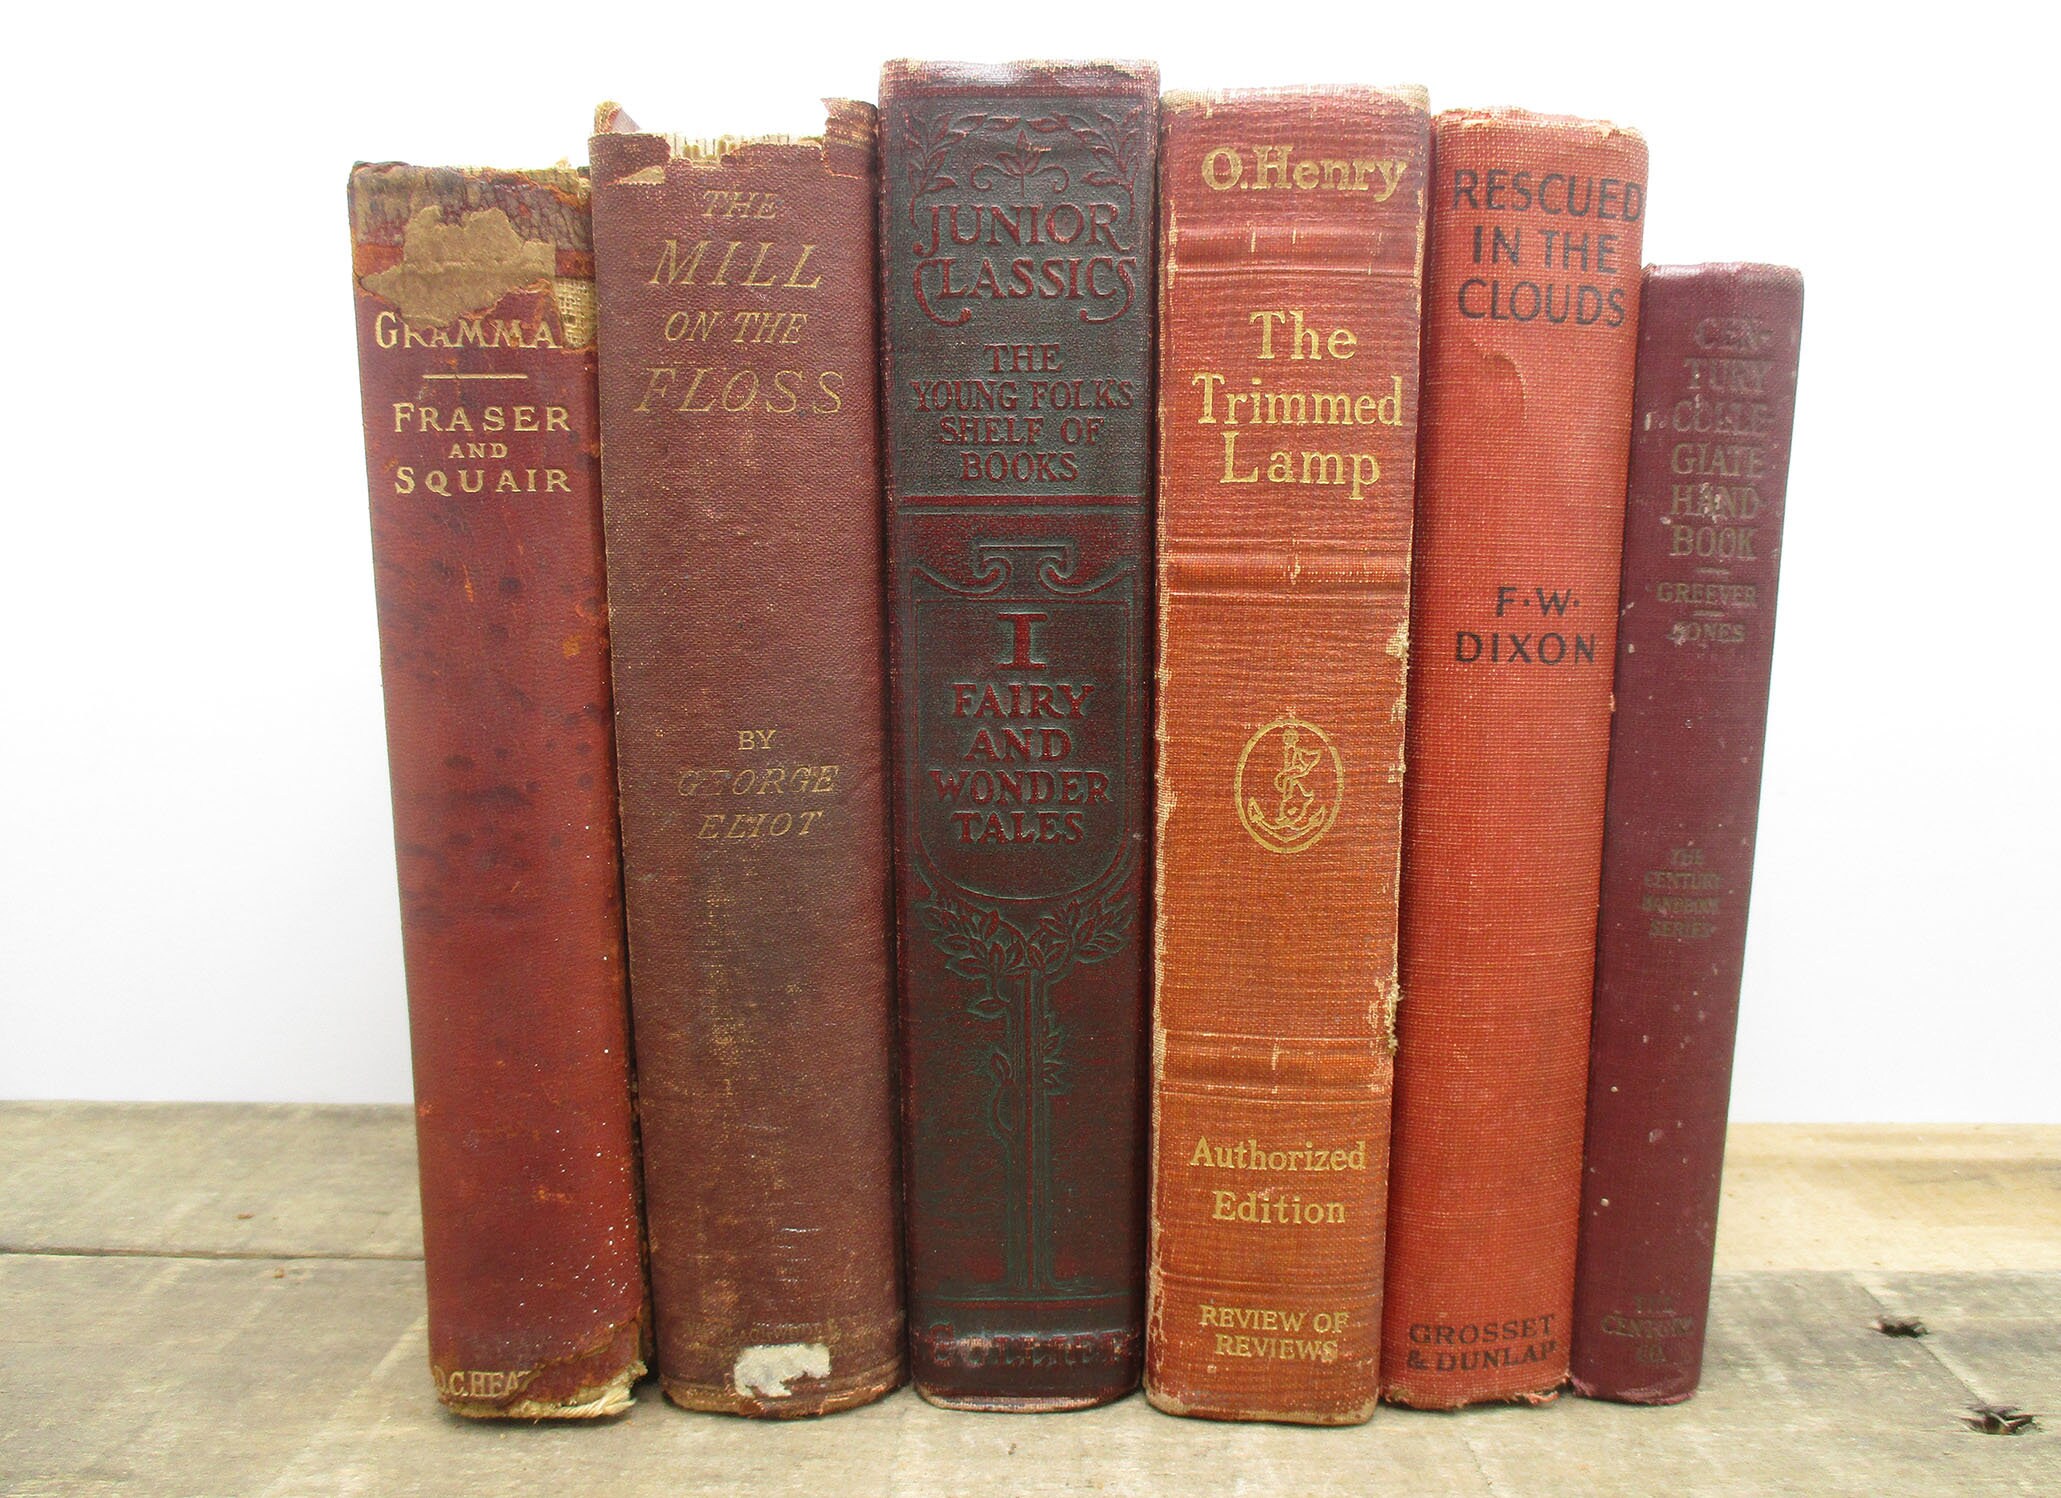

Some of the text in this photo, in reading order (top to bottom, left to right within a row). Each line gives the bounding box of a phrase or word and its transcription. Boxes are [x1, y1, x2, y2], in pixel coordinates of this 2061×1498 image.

[702, 190, 780, 219] THE
[1451, 168, 1644, 222] RESCUED
[912, 202, 1134, 257] JUNIOR
[648, 239, 822, 288] MILL
[1472, 225, 1620, 274] IN THE
[913, 255, 1137, 327] CLASSICS
[1456, 277, 1626, 328] CLOUDS
[664, 311, 808, 343] ON THE
[1250, 310, 1358, 361] The
[984, 343, 1063, 373] THE
[633, 367, 844, 414] FLOSS
[908, 379, 1136, 412] YOUNG FOLKS
[1191, 371, 1403, 426] Trimmed
[392, 402, 571, 432] FRASER
[938, 416, 1105, 445] SHELF OF
[448, 442, 508, 459] AND
[959, 451, 1079, 483] BOOKS
[1219, 430, 1381, 501] Lamp
[1671, 441, 1767, 479] GIATE
[395, 466, 572, 497] SQUAIR
[1669, 524, 1758, 561] BOOK
[996, 612, 1048, 670] I
[1455, 631, 1596, 665] DIXON
[951, 682, 1096, 719] FAIRY
[737, 730, 777, 750] BY
[962, 728, 1073, 762] AND
[677, 764, 840, 796] GEORGE
[926, 769, 1114, 805] WONDER
[698, 810, 823, 839] ELIOT
[950, 810, 1085, 844] TALES
[1189, 1135, 1366, 1172] Authorized
[1211, 1190, 1347, 1224] Edition
[1199, 1303, 1350, 1335] REVIEW OF
[1407, 1313, 1556, 1344] GROSSET
[1213, 1333, 1339, 1362] REVIEWS
[1407, 1340, 1557, 1373] & DUNLAP
